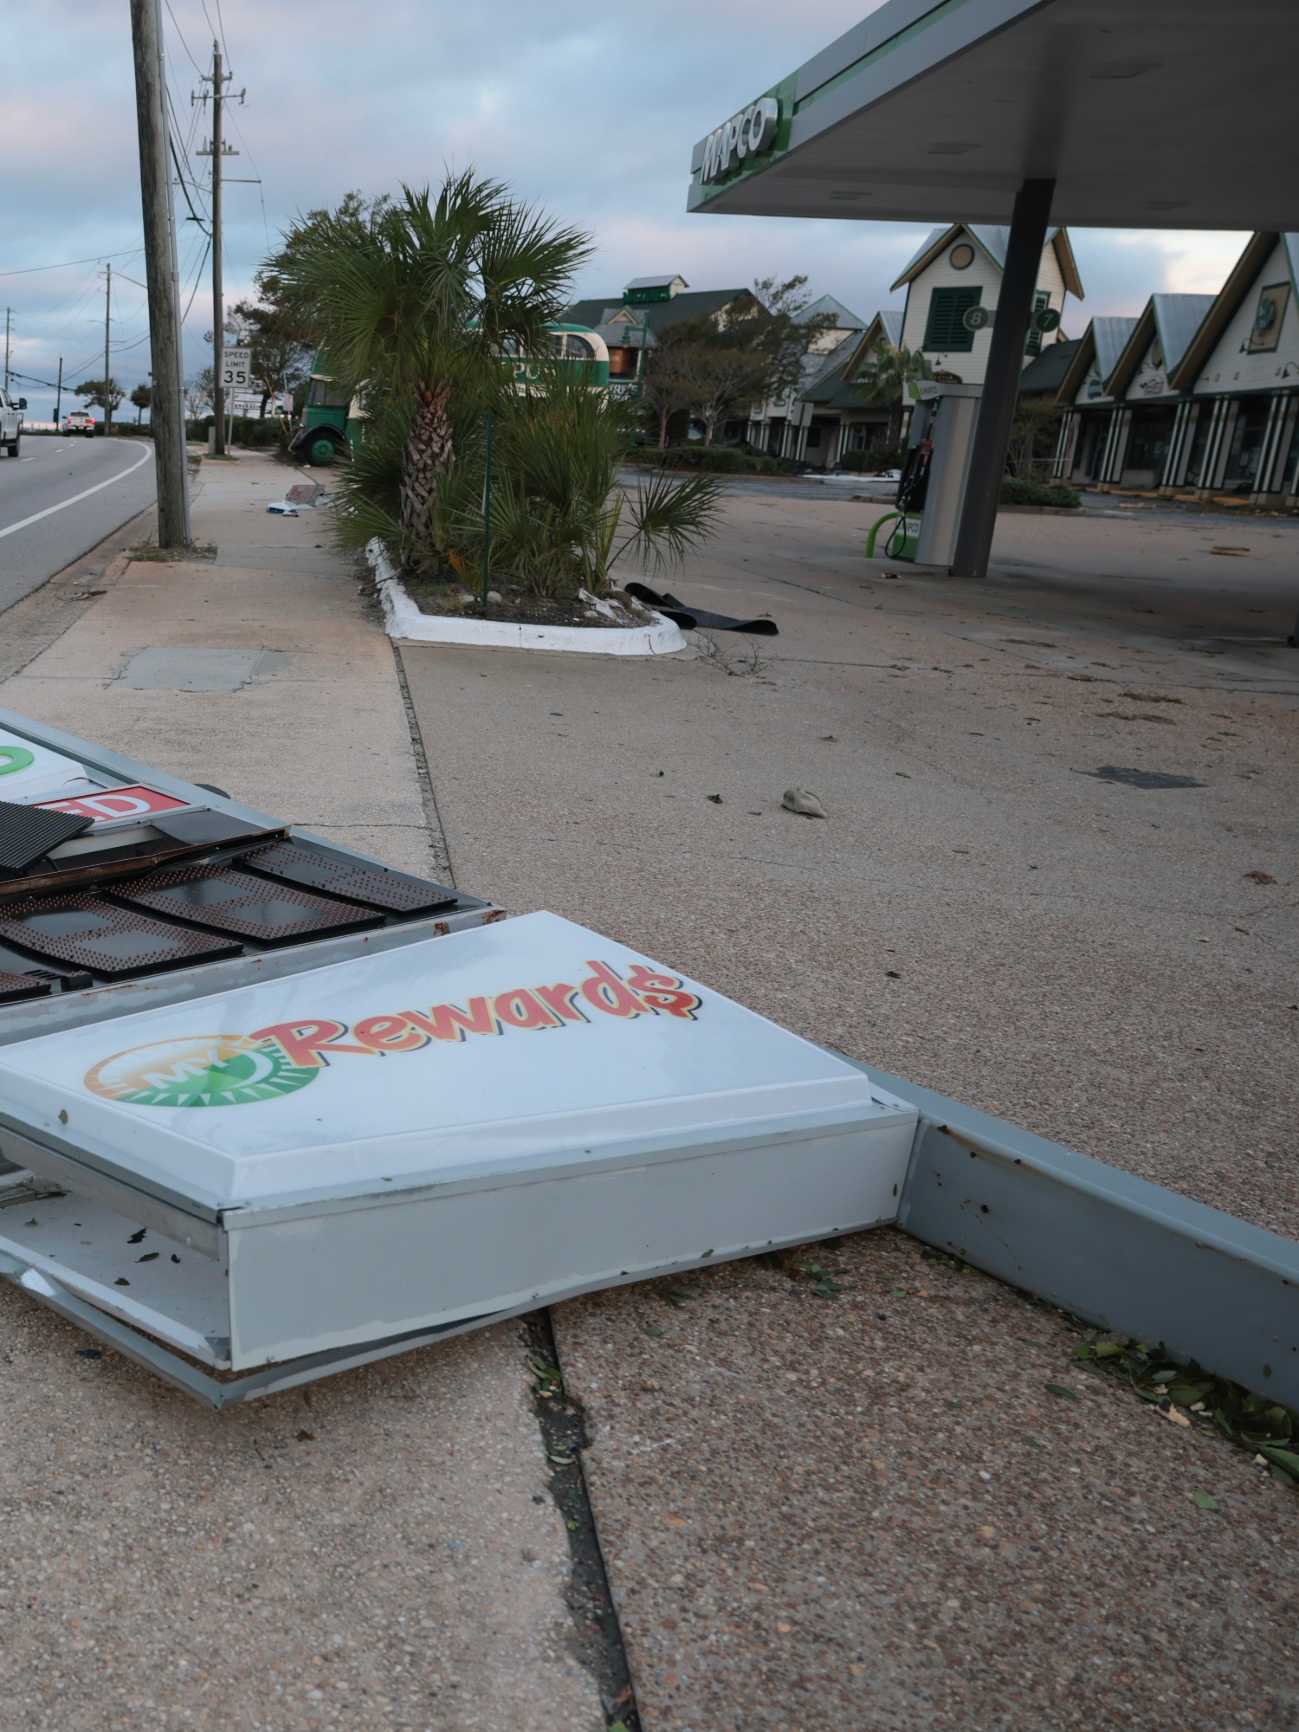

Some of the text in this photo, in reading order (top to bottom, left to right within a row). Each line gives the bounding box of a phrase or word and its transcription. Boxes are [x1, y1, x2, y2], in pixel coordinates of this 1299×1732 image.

[699, 97, 778, 185] MAPCO
[970, 312, 982, 325] 8
[1043, 314, 1053, 327] 7
[224, 351, 249, 359] SPEED
[223, 370, 246, 384] 35
[141, 1046, 229, 1091] MY
